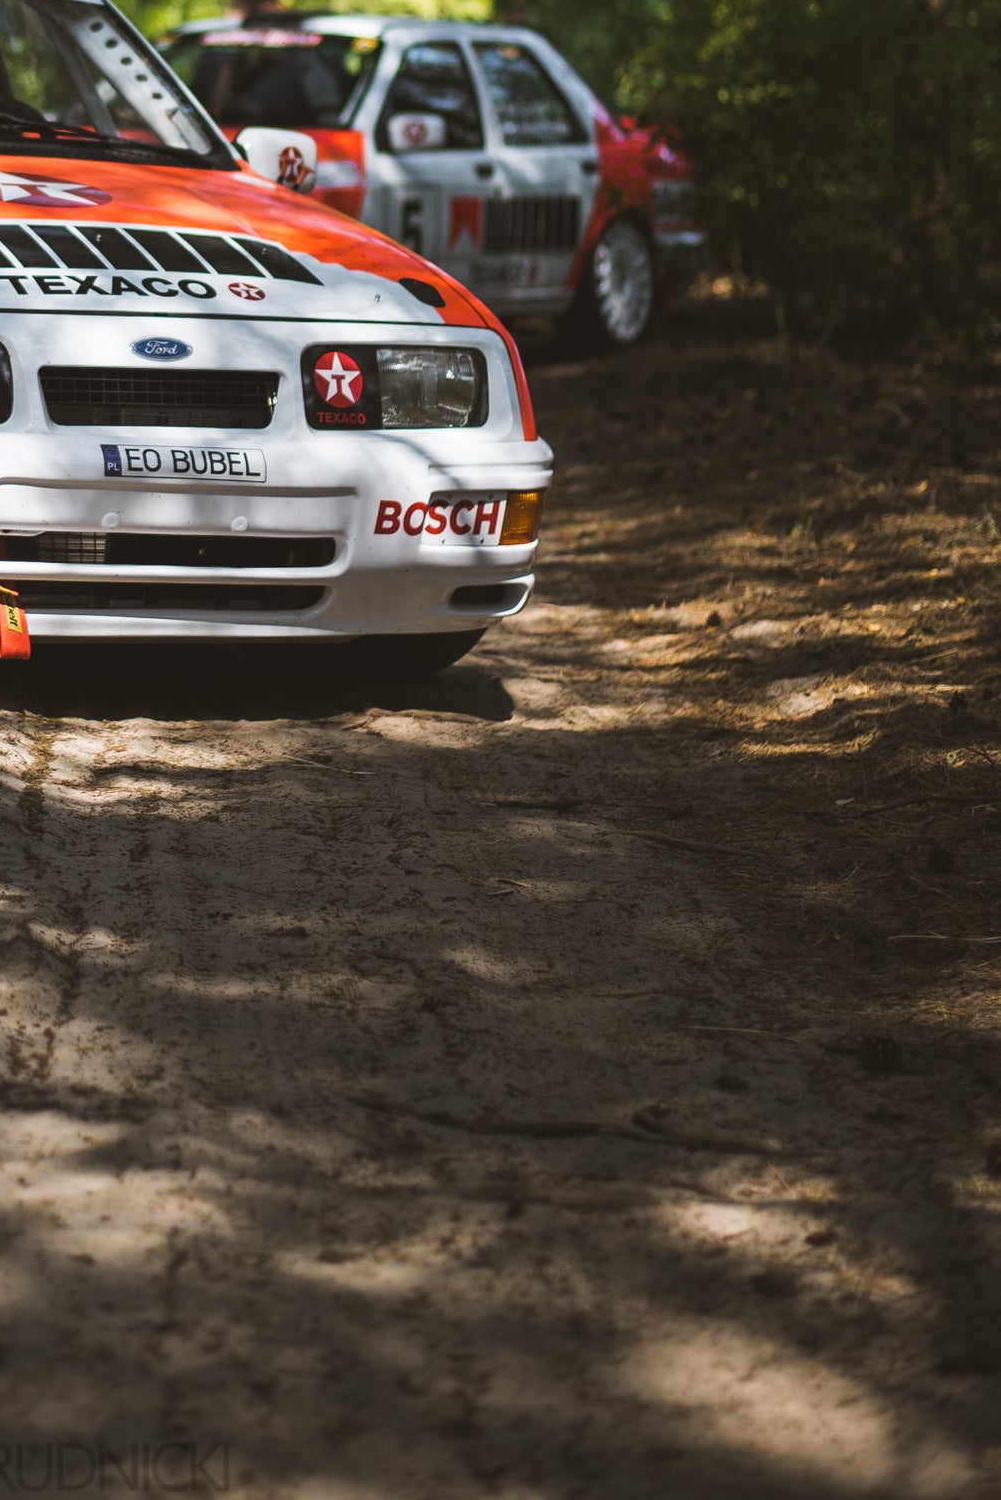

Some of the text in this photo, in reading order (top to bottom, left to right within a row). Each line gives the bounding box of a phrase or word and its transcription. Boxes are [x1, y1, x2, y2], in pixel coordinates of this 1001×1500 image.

[145, 340, 178, 354] Ford
[317, 412, 367, 425] TEXACO
[107, 463, 120, 471] PL
[125, 448, 261, 476] EO BUBEL
[374, 500, 500, 536] BOSCH
